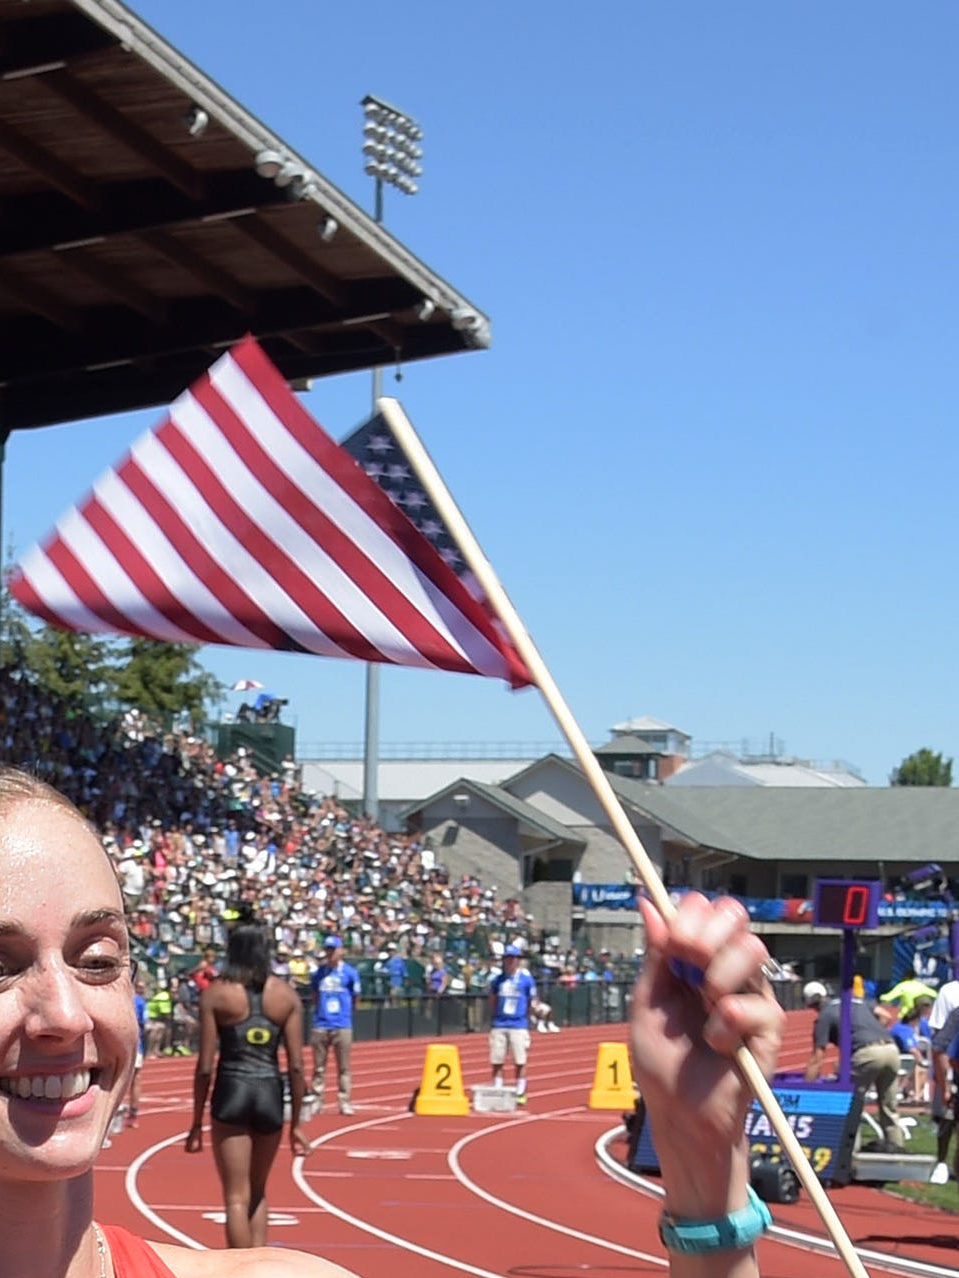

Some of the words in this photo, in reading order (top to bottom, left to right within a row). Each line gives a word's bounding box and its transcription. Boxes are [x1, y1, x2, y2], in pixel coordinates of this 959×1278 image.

[843, 886, 869, 924] 0
[435, 1063, 452, 1090] 2
[607, 1060, 618, 1085] 1
